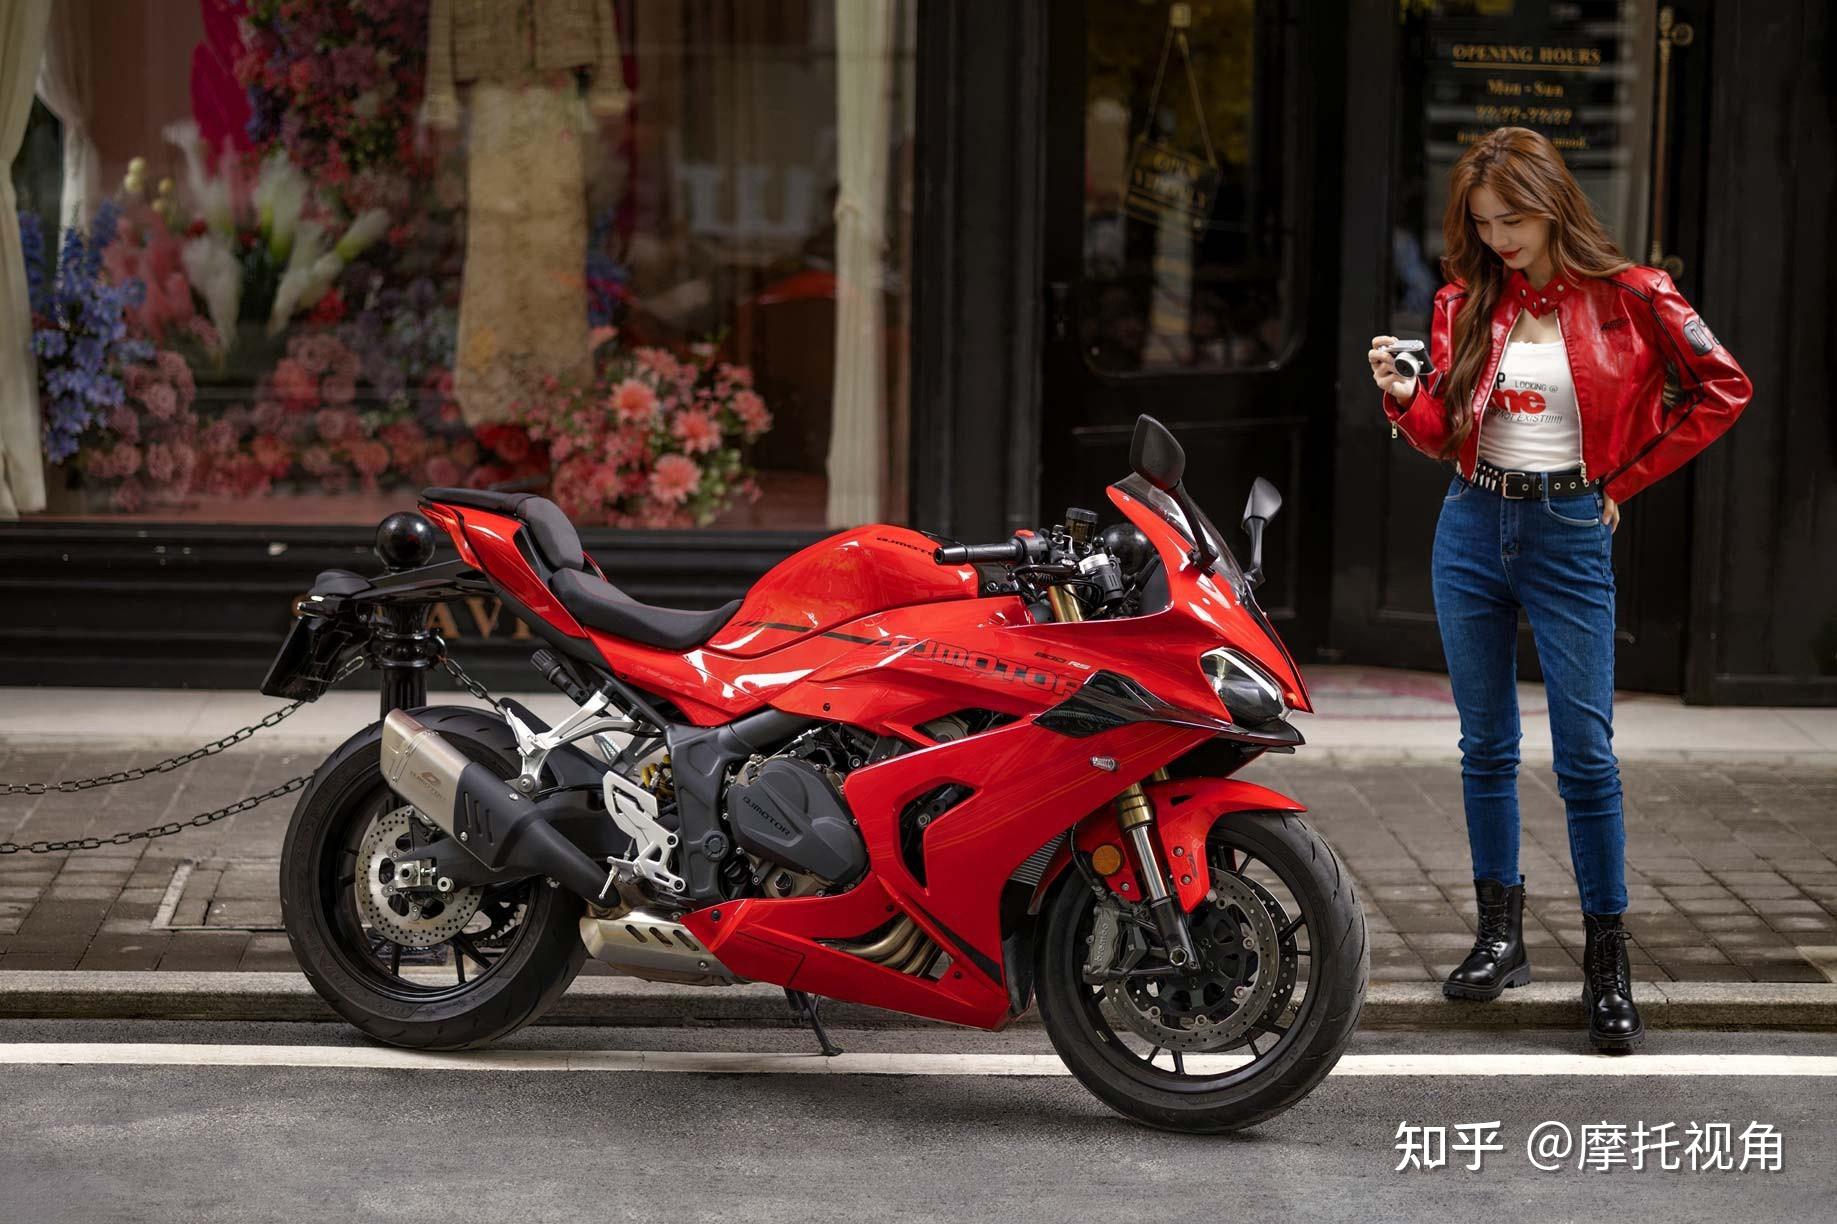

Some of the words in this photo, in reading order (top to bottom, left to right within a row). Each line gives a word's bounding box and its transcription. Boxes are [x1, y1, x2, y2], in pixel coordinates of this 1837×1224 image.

[1452, 44, 1534, 63] OPENING
[1538, 46, 1601, 65] HOURS
[1487, 78, 1522, 96] Mon
[1534, 79, 1564, 98] Sun
[1494, 372, 1506, 390] P
[742, 796, 791, 836] QJMOTOR
